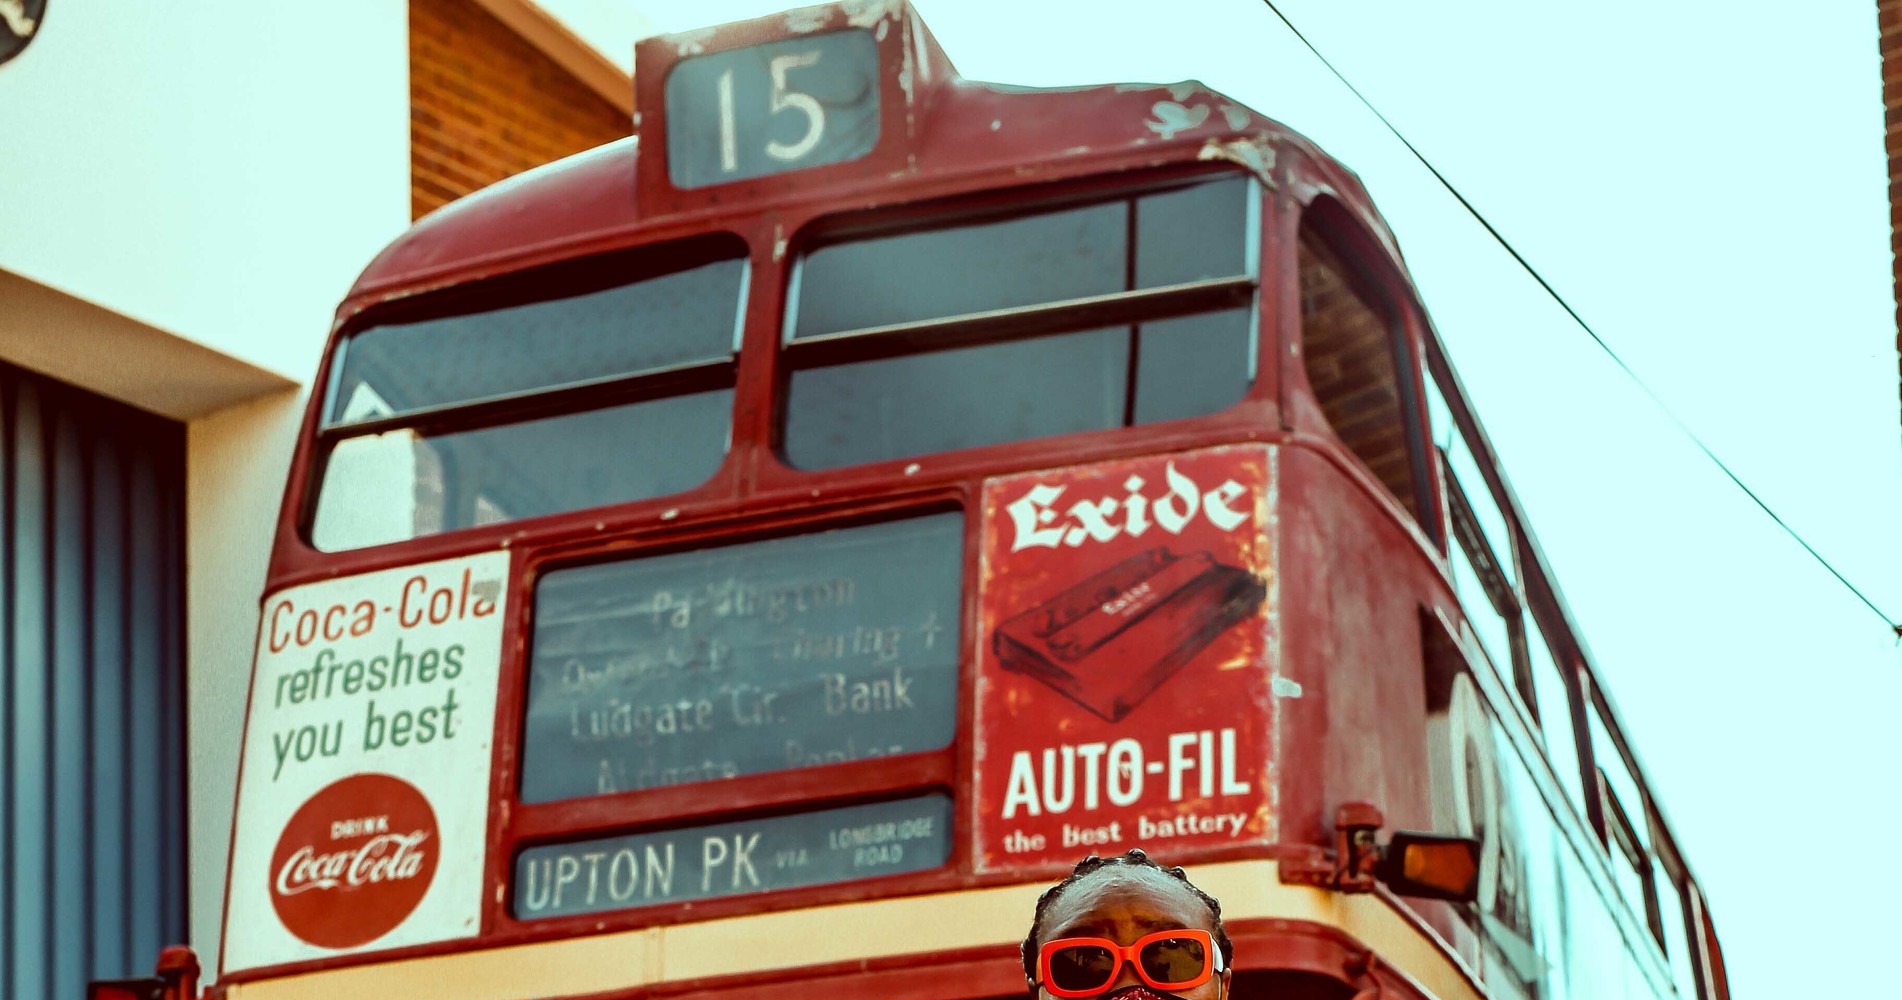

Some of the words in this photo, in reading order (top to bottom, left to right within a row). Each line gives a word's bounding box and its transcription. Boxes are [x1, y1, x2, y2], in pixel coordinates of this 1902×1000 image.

[718, 50, 826, 173] 15
[1006, 460, 1254, 553] Exide
[268, 567, 497, 655] Coca-Cola
[275, 637, 466, 710] refreshes
[818, 664, 915, 718] Bank
[271, 719, 344, 783] you
[363, 687, 460, 753] best
[1000, 727, 1252, 820] AUTO-FIL
[330, 814, 391, 842] DRINK
[853, 843, 904, 868] ROAD
[1003, 831, 1047, 854] the
[1062, 820, 1123, 849] best
[1138, 811, 1249, 840] battery
[525, 842, 675, 912] UPTON
[702, 832, 762, 892] PK
